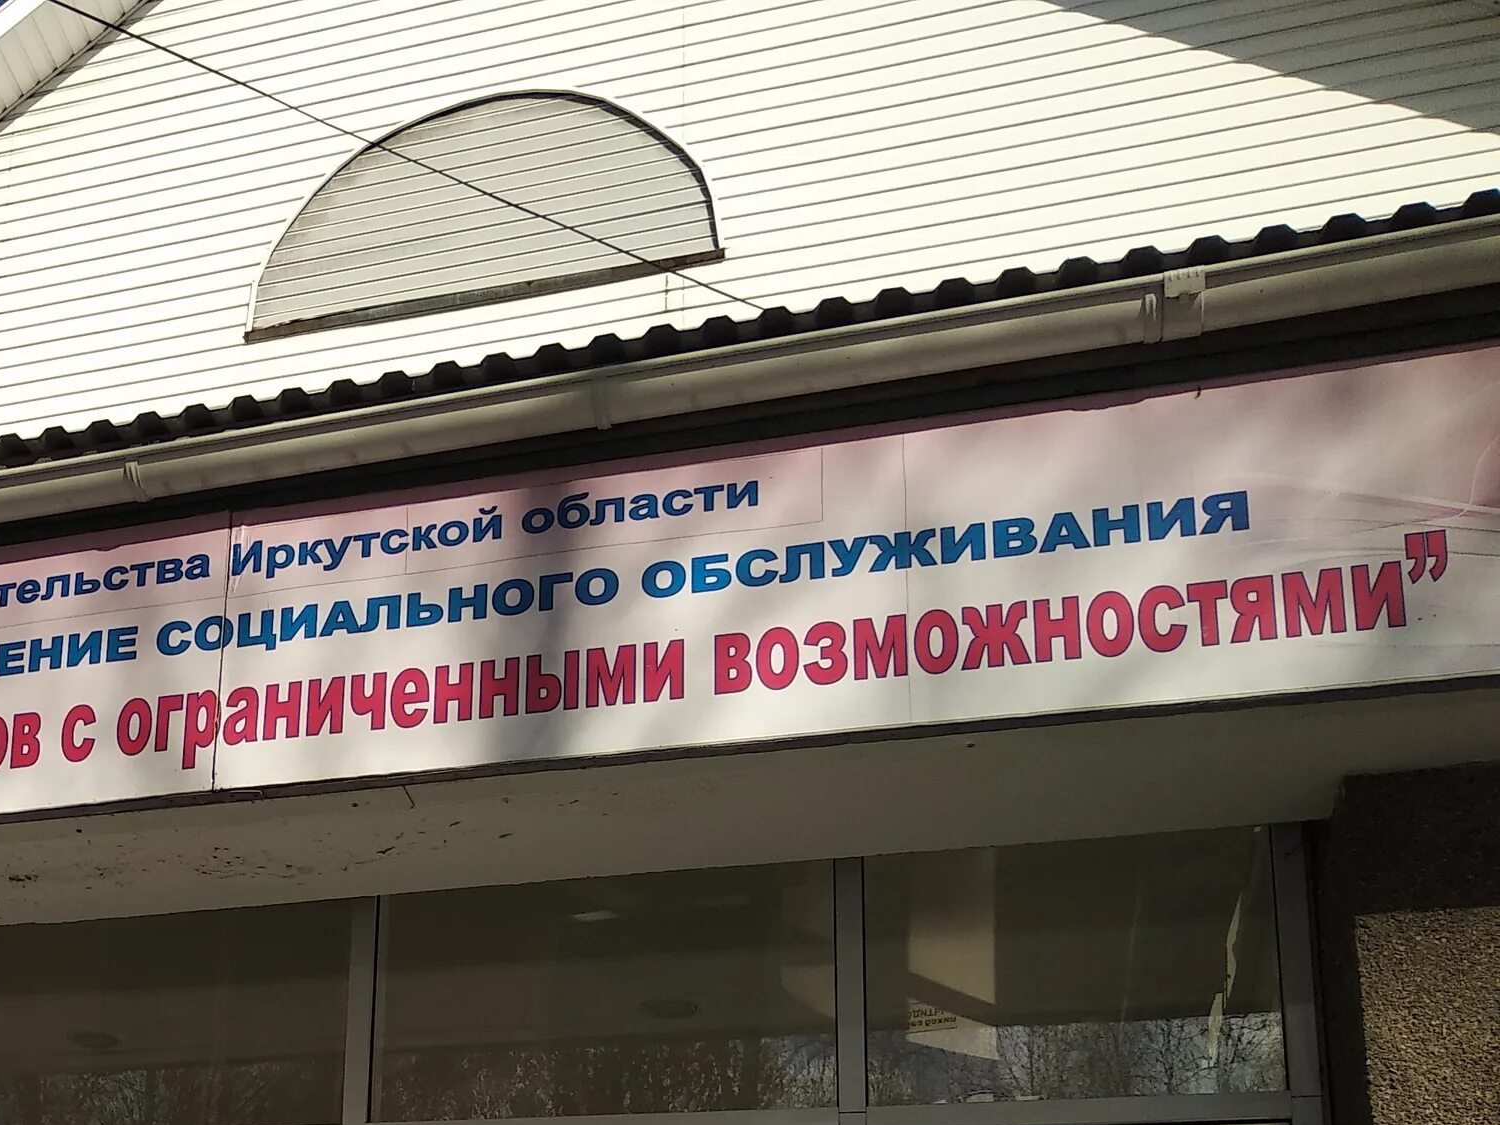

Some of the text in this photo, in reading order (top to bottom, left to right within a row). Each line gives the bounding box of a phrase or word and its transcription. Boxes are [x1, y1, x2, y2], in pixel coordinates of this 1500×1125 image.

[156, 567, 619, 651] СОЦИАЛЬНОГО
[641, 490, 1249, 598] ОБСЛУЖИВАНИЯ
[230, 507, 502, 579] Иркутской
[521, 480, 759, 534] области
[61, 704, 96, 762] с
[116, 638, 685, 770] ограниченными
